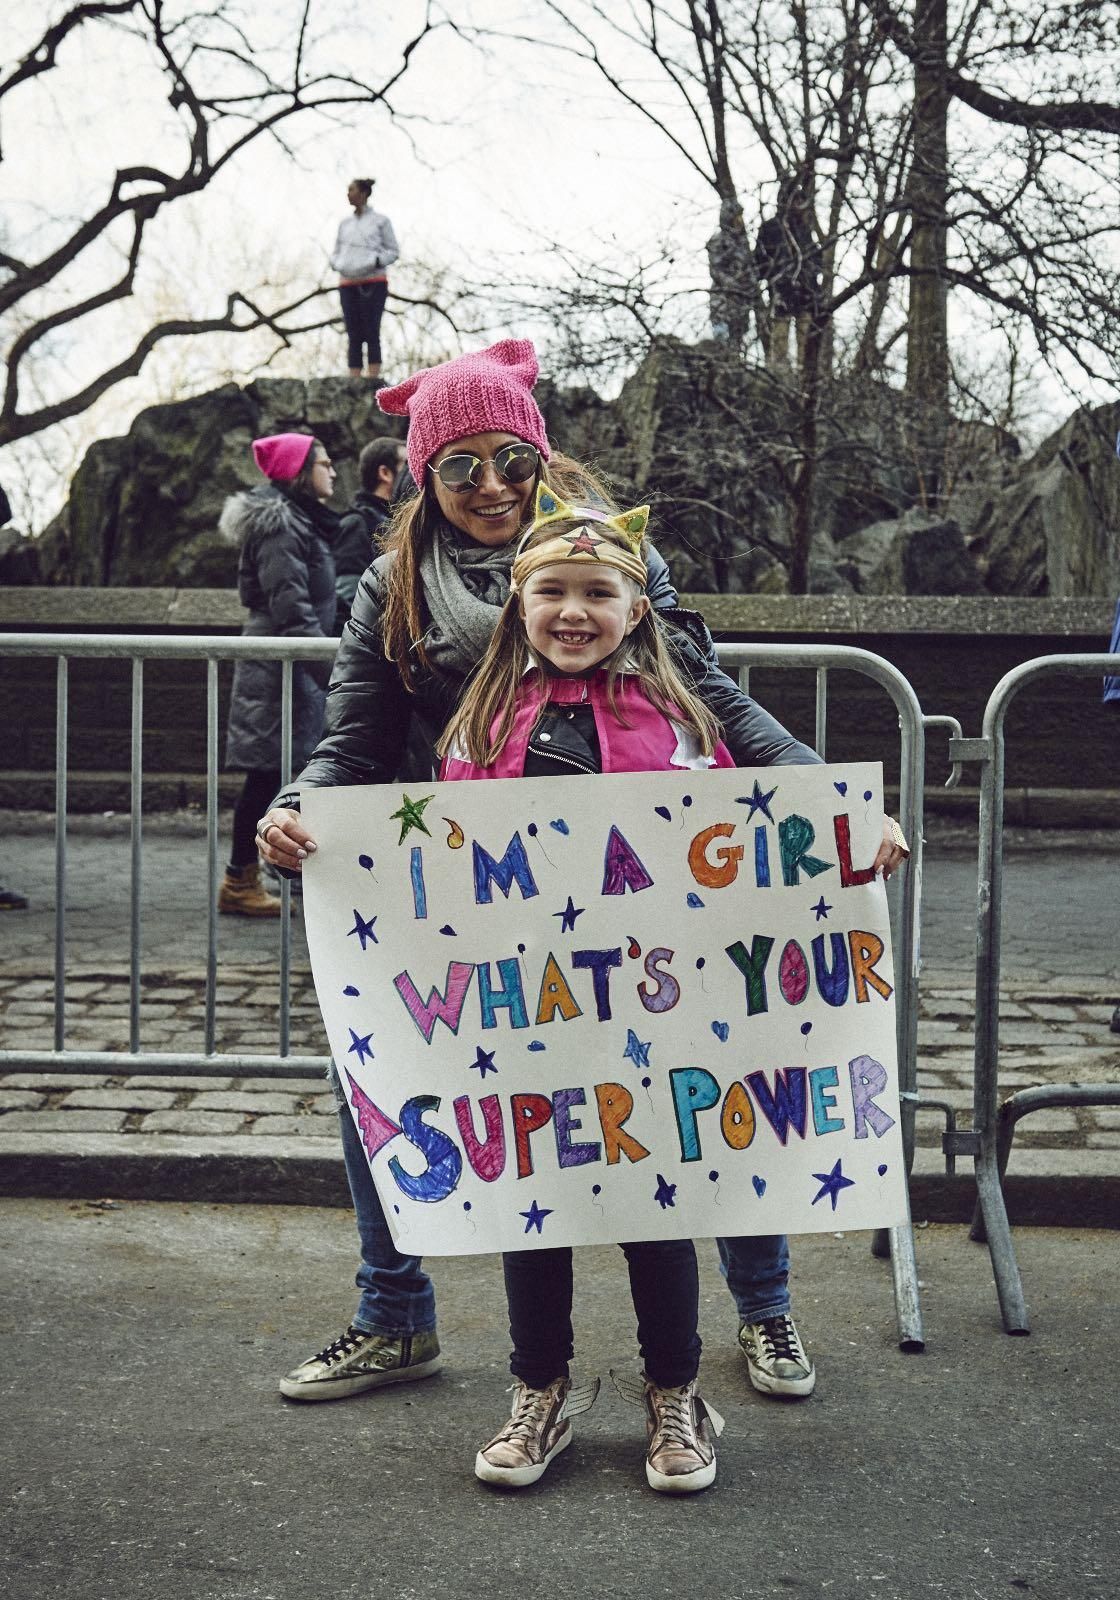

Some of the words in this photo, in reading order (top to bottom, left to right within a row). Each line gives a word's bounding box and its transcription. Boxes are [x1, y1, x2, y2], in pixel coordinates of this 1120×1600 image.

[410, 817, 540, 919] I'M
[601, 824, 654, 896] A
[687, 813, 877, 888] GIRL
[392, 936, 681, 1045] WHAT'S
[724, 930, 894, 1016] YOUR
[387, 1082, 651, 1203] SUPER
[668, 1055, 895, 1163] POWER
